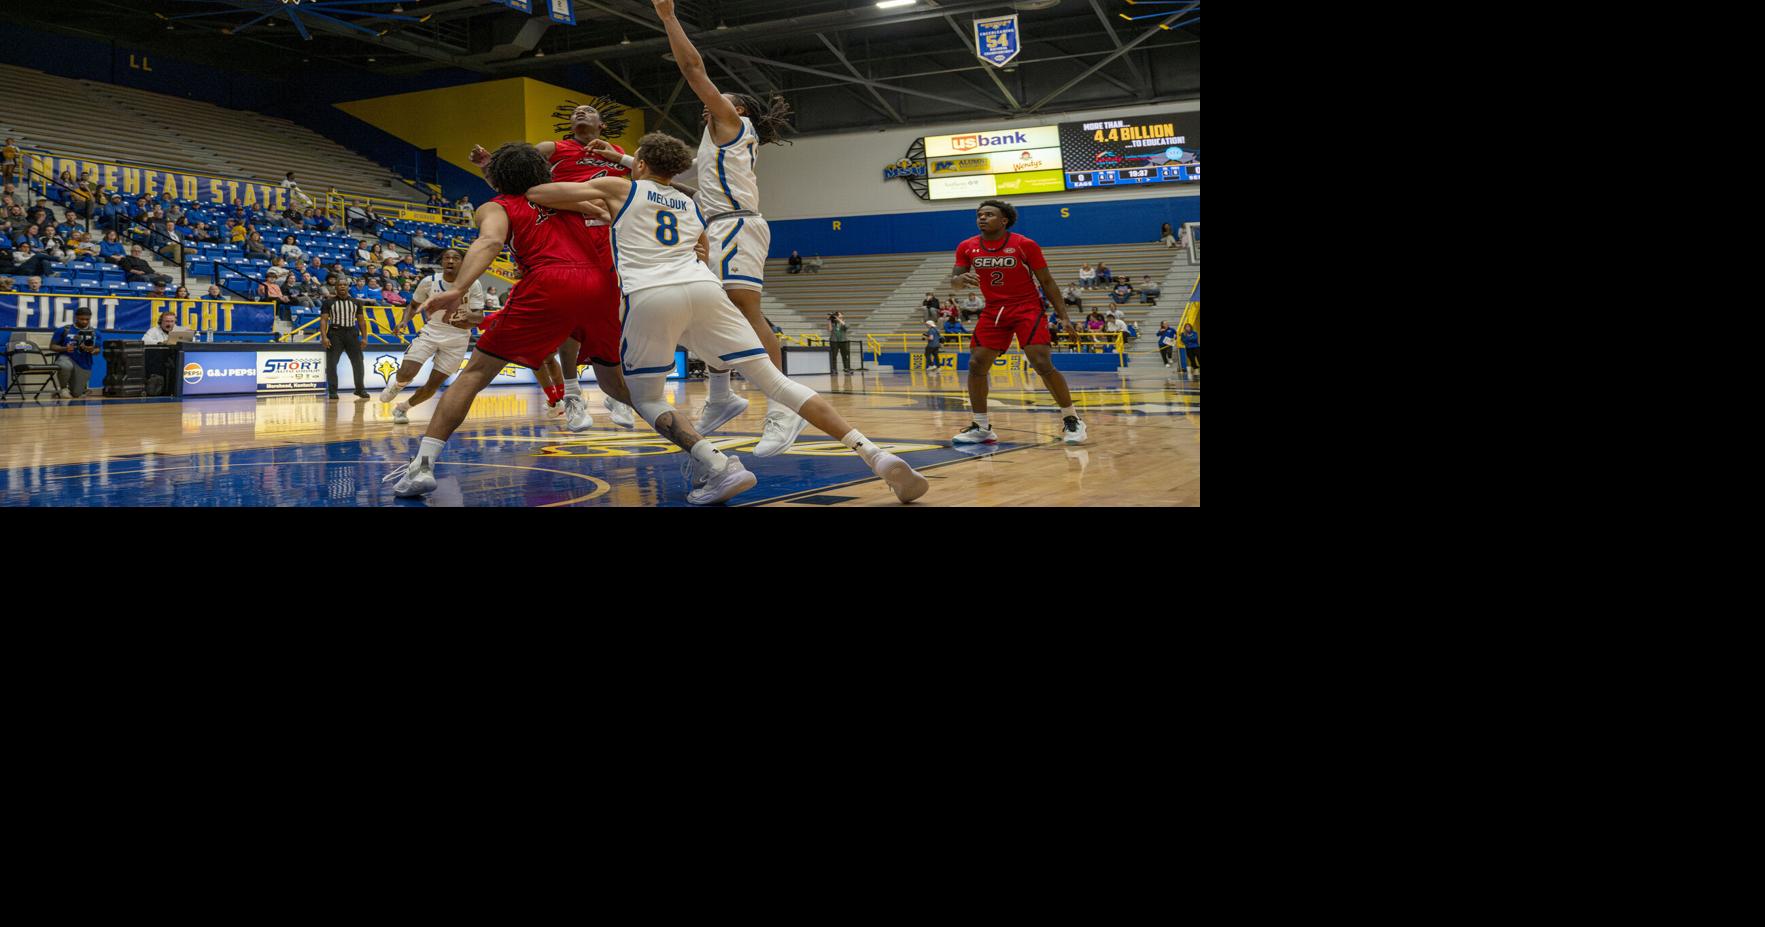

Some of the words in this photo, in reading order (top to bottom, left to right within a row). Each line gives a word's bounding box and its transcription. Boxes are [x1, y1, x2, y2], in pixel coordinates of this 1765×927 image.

[986, 33, 1008, 48] 54
[1083, 122, 1104, 131] MORE
[1094, 128, 1119, 142] 4.4
[1120, 123, 1175, 141] BILLION
[1142, 136, 1186, 147] EDUCATION!
[31, 154, 197, 200] MOREHEAD
[210, 179, 287, 211] STATE
[647, 190, 687, 211] MELLOUK
[1060, 207, 1070, 218] S
[656, 210, 679, 247] 8
[832, 220, 842, 231] R
[973, 256, 1016, 268] SEMO
[991, 271, 1004, 286] 2
[17, 296, 119, 330] FIGHT
[207, 369, 227, 377] G&J
[228, 368, 256, 377] PEPSI
[263, 359, 321, 373] SHORT
